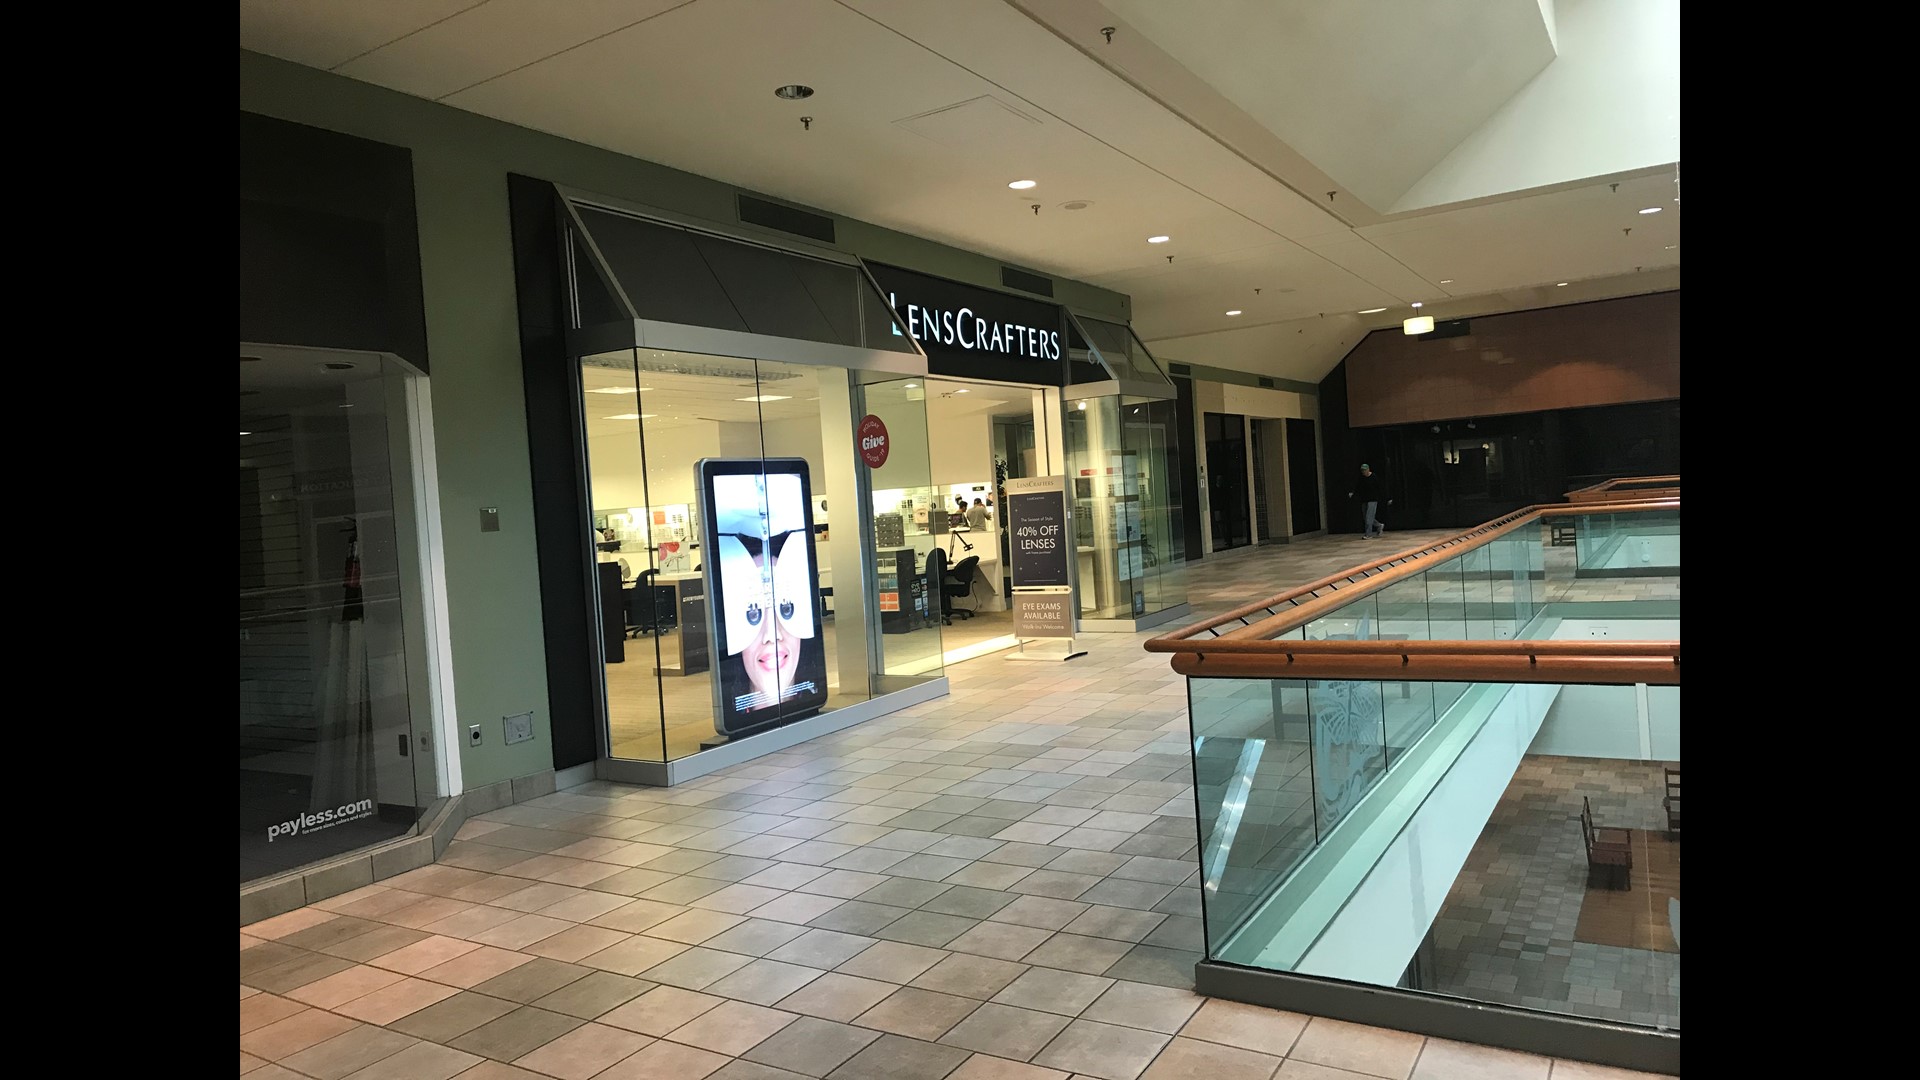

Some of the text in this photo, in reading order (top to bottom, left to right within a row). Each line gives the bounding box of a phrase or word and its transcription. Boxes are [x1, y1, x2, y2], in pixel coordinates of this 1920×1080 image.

[890, 292, 1060, 361] LENSCRAFTERS
[862, 434, 885, 451] Give
[1016, 525, 1059, 537] 40% OFF
[1020, 538, 1056, 550] LENSES
[1022, 602, 1061, 611] EYE EXAMS
[1023, 611, 1061, 620] AVAILABLE
[267, 798, 372, 842] payless.com
